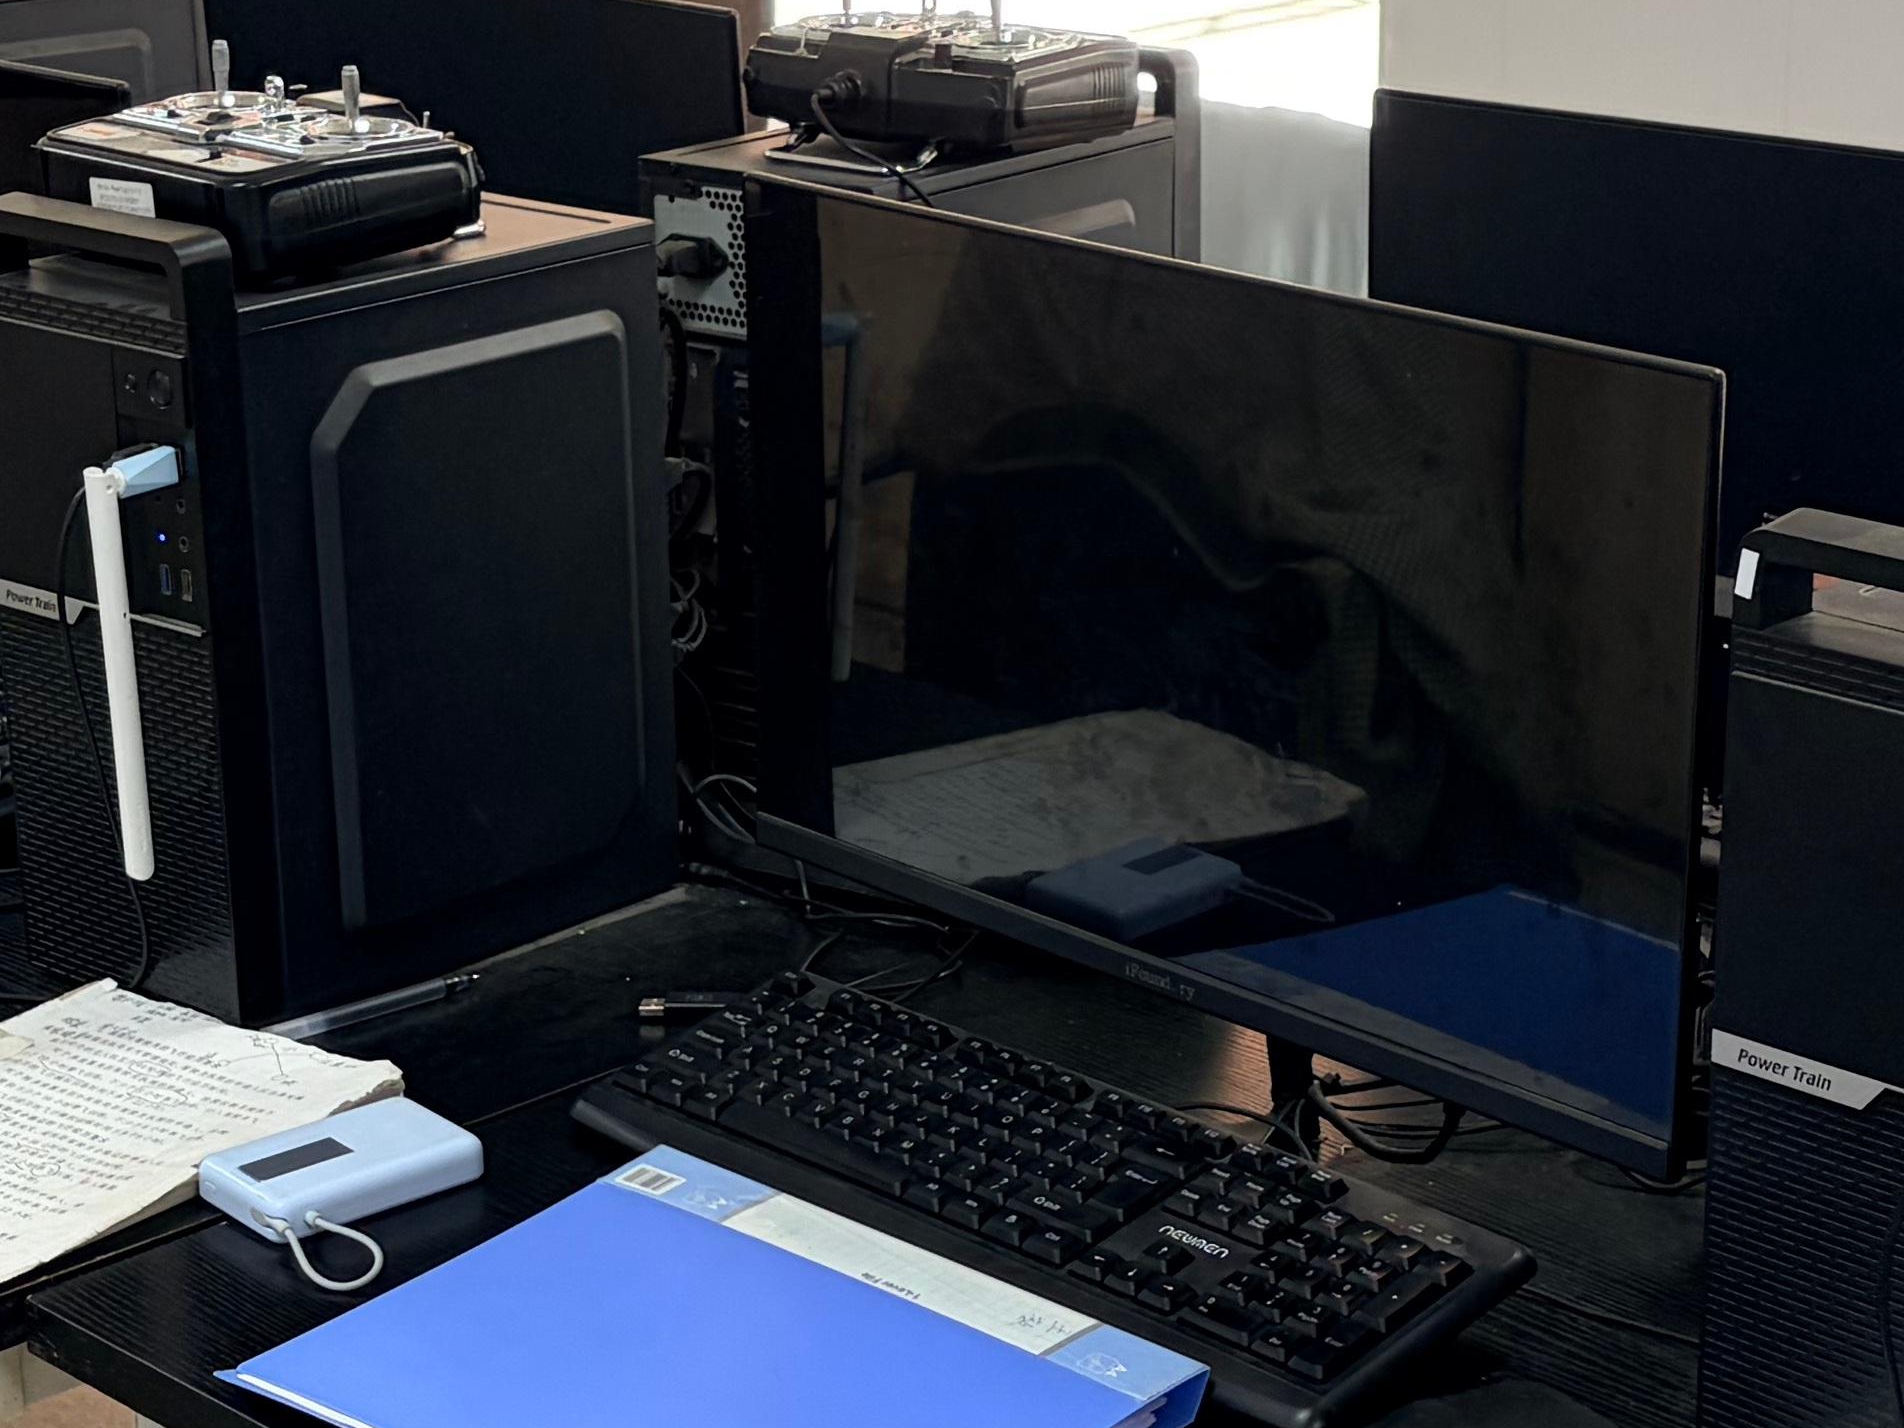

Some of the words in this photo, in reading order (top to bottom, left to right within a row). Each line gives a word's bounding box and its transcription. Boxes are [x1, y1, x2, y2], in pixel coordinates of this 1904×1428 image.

[6, 588, 34, 607] Power
[1737, 1047, 1790, 1077] Power
[1793, 1065, 1832, 1091] Train
